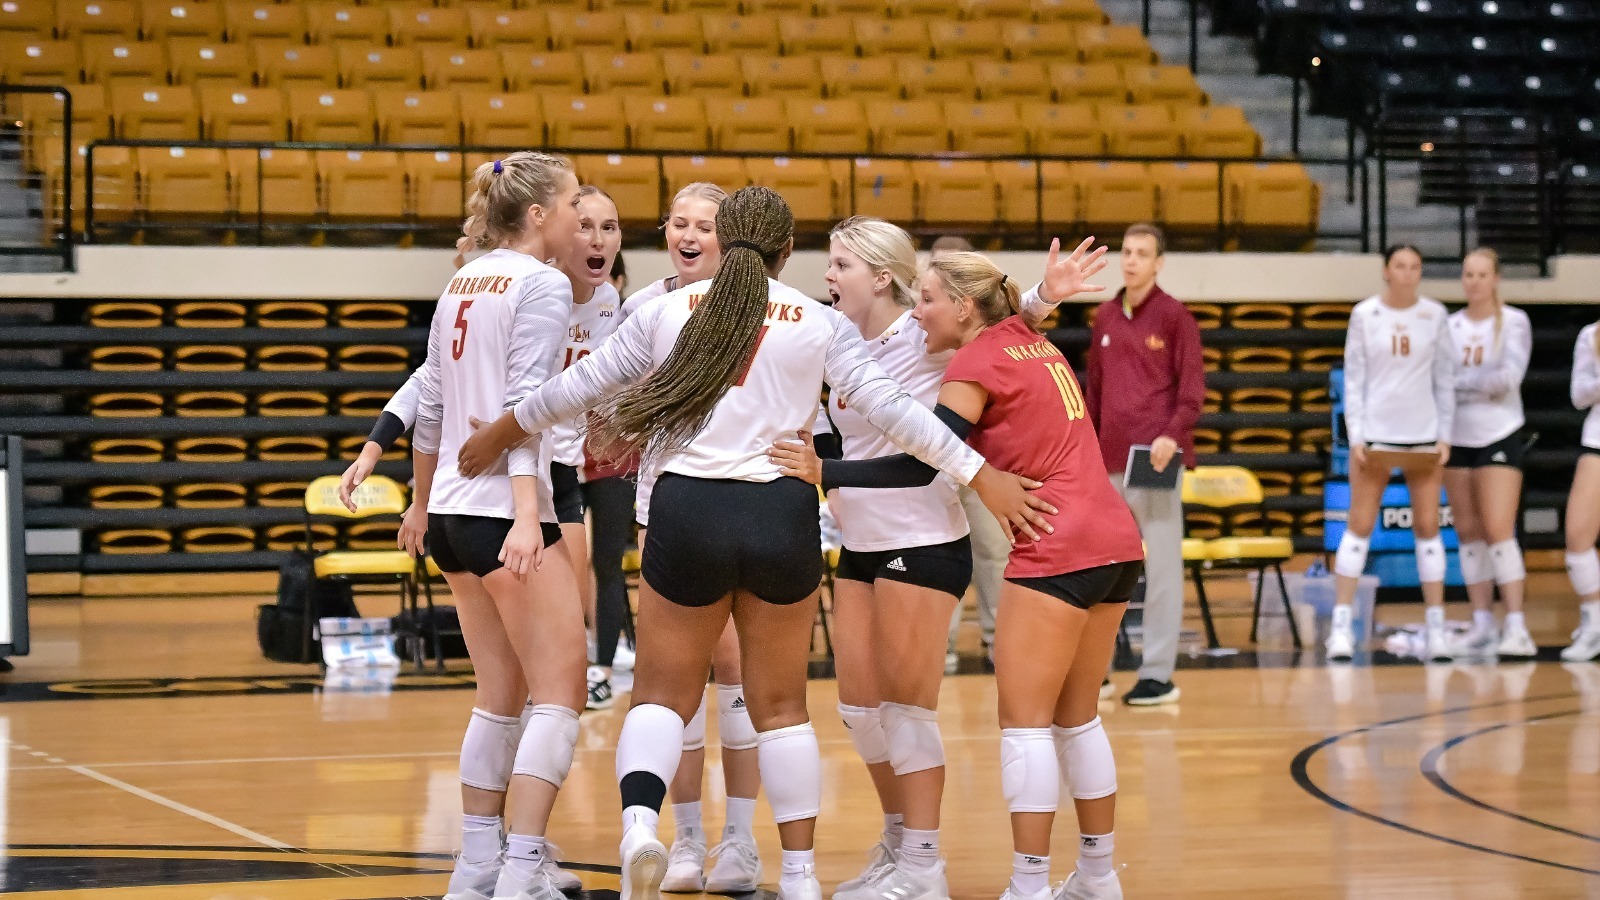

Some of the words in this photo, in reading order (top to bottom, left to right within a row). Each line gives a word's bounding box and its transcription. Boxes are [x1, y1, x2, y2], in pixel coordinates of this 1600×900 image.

[448, 275, 512, 295] WARHAWKS
[689, 294, 803, 322] WWKS
[452, 299, 475, 361] 5
[568, 323, 590, 343] ULM
[1392, 335, 1410, 357] 18
[1043, 362, 1085, 421] 10
